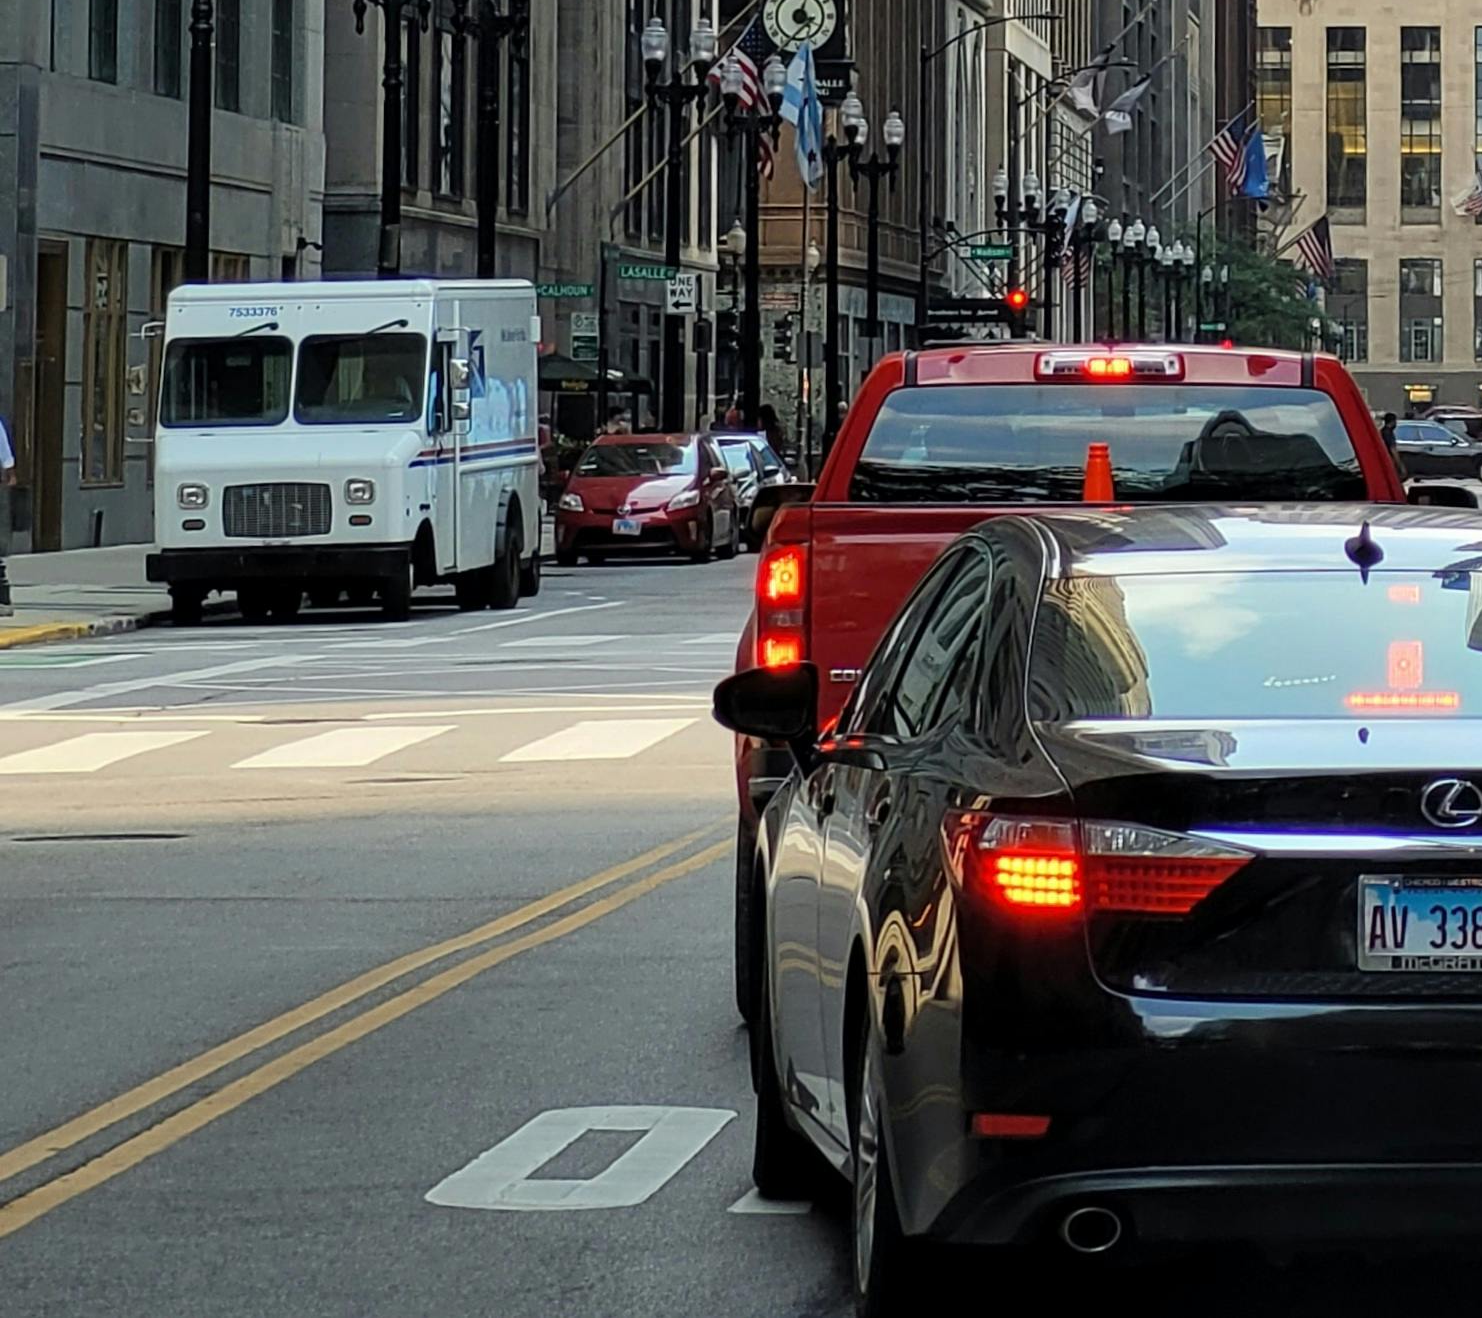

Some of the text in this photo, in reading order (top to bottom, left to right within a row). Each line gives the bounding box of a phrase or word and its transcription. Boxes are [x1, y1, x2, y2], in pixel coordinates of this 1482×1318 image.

[621, 266, 666, 279] LASALLE
[541, 285, 587, 296] CALHOUN
[670, 288, 693, 297] WAY
[229, 307, 278, 317] 7533376
[1369, 905, 1408, 949] AV
